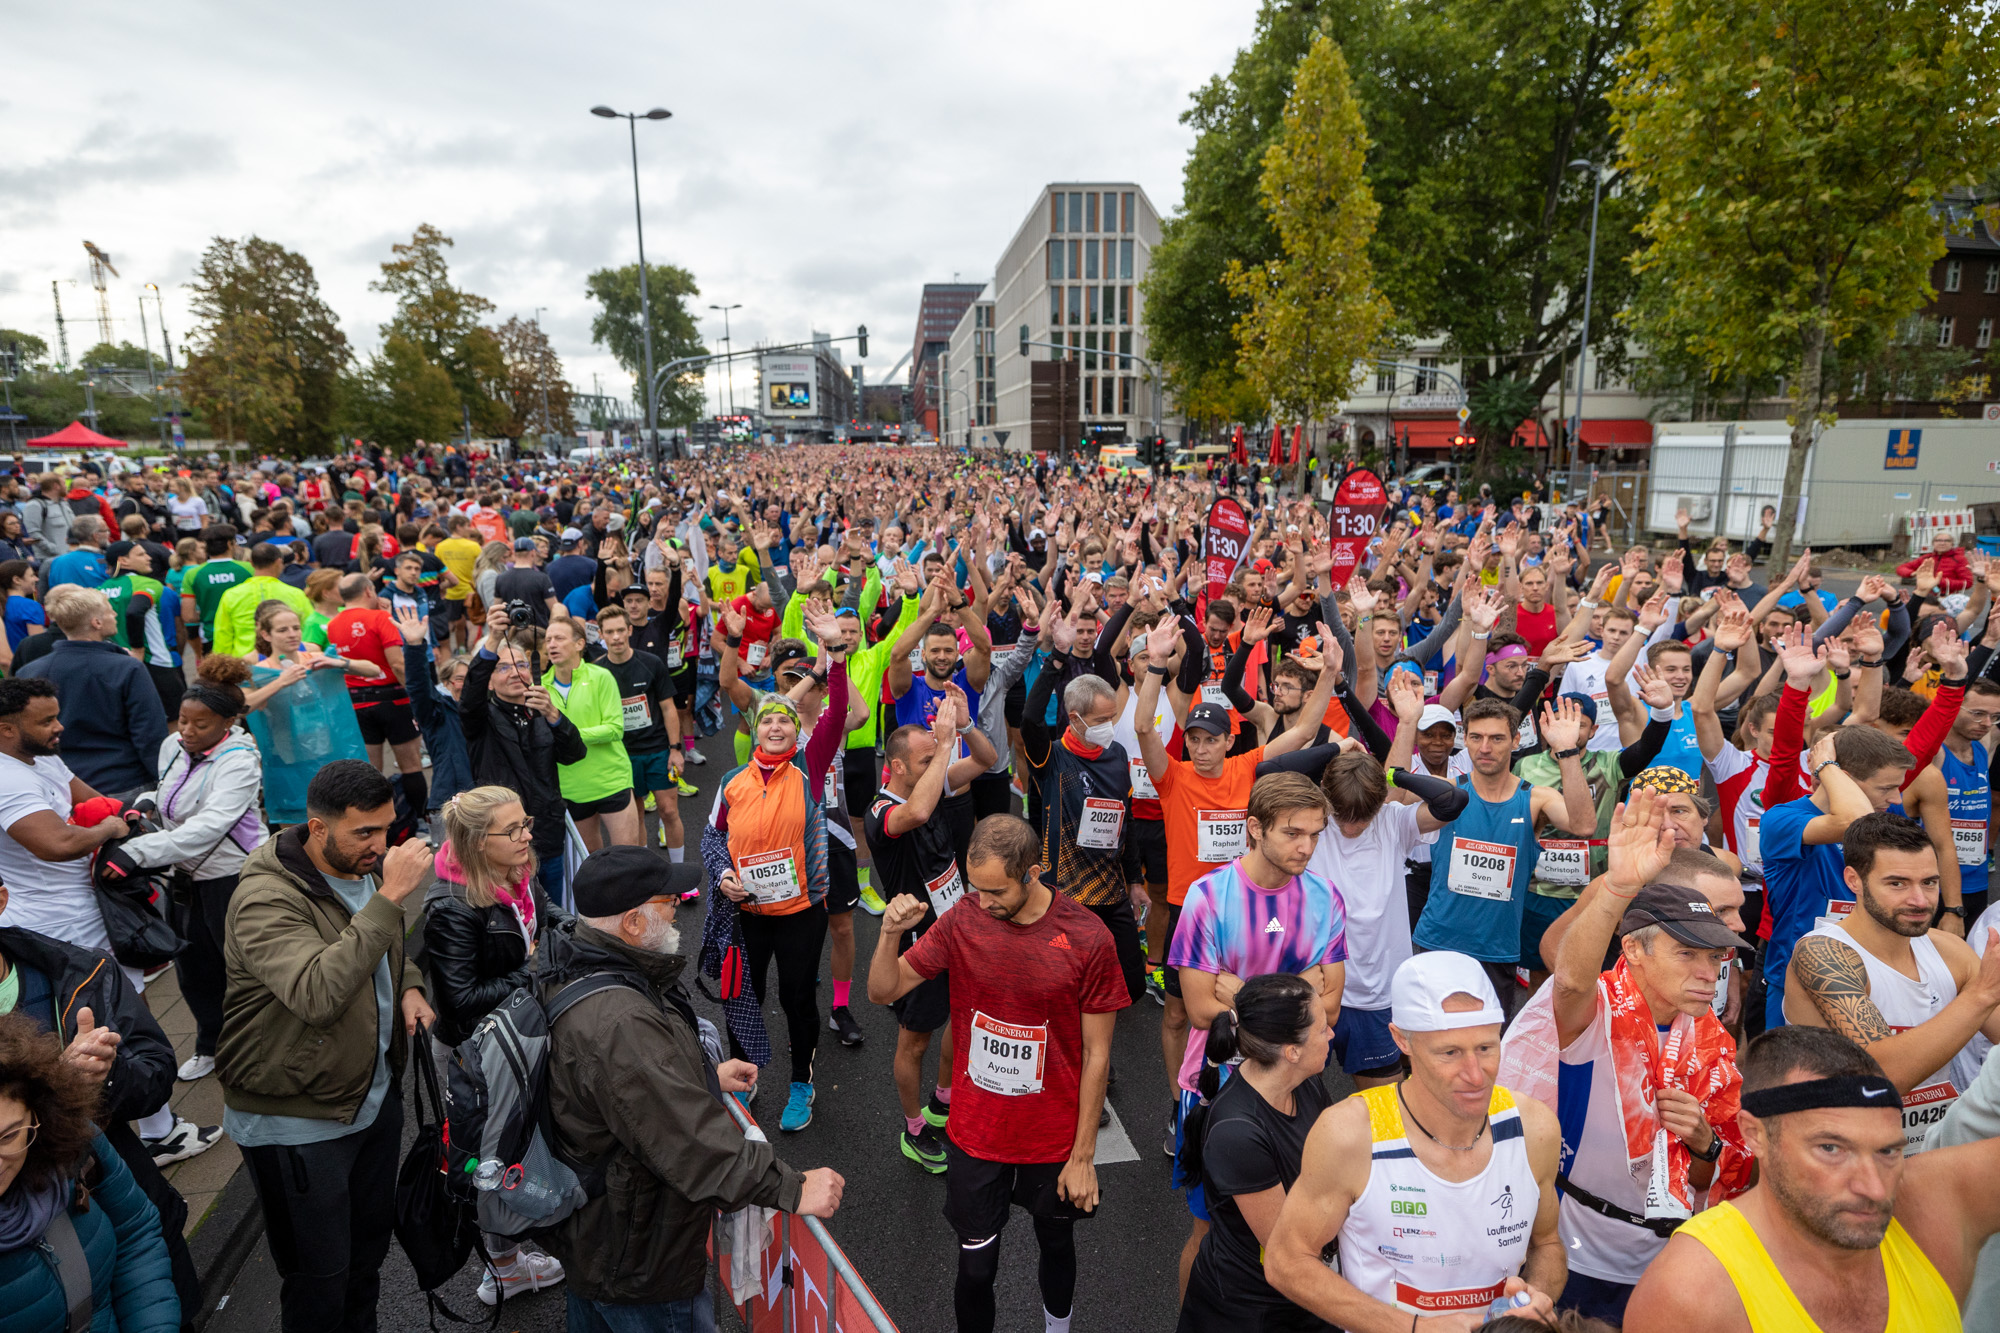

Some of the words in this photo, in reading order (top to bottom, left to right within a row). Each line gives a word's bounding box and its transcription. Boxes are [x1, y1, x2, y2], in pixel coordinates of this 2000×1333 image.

[1886, 457, 1917, 468] BAUER
[1335, 506, 1351, 515] SUB
[1209, 527, 1221, 536] SUB
[1336, 514, 1376, 536] 1:30
[1209, 534, 1239, 560] 1:30
[208, 572, 236, 585] HDI
[623, 703, 643, 714] 2400
[1090, 811, 1118, 824] 20220
[1093, 827, 1113, 835] Karsten
[1208, 823, 1244, 836] 15537
[1212, 840, 1240, 849] Raphael
[1475, 843, 1507, 855] GENERALI
[755, 852, 784, 863] GENERALI
[1463, 853, 1505, 871] 10208
[1544, 851, 1580, 863] 13443
[748, 863, 786, 880] 10528
[1544, 865, 1580, 874] Christoph
[1471, 872, 1492, 882] Sven
[1048, 940, 1072, 950] adidas
[994, 1024, 1034, 1039] GENERALI
[982, 1035, 1032, 1060] 18018
[1665, 1029, 1683, 1061] plus
[987, 1061, 1020, 1075] Ayoub
[983, 1080, 1004, 1092] MARATHON
[1911, 1087, 1947, 1103] GENERALI
[1902, 1104, 1947, 1129] 10426
[1399, 1185, 1426, 1193] Raiffeisen
[1393, 1202, 1426, 1214] BFA
[1487, 1219, 1528, 1237] Lauffreunde
[1498, 1233, 1522, 1248] Sarntal
[1436, 1290, 1495, 1306] GENERALI
